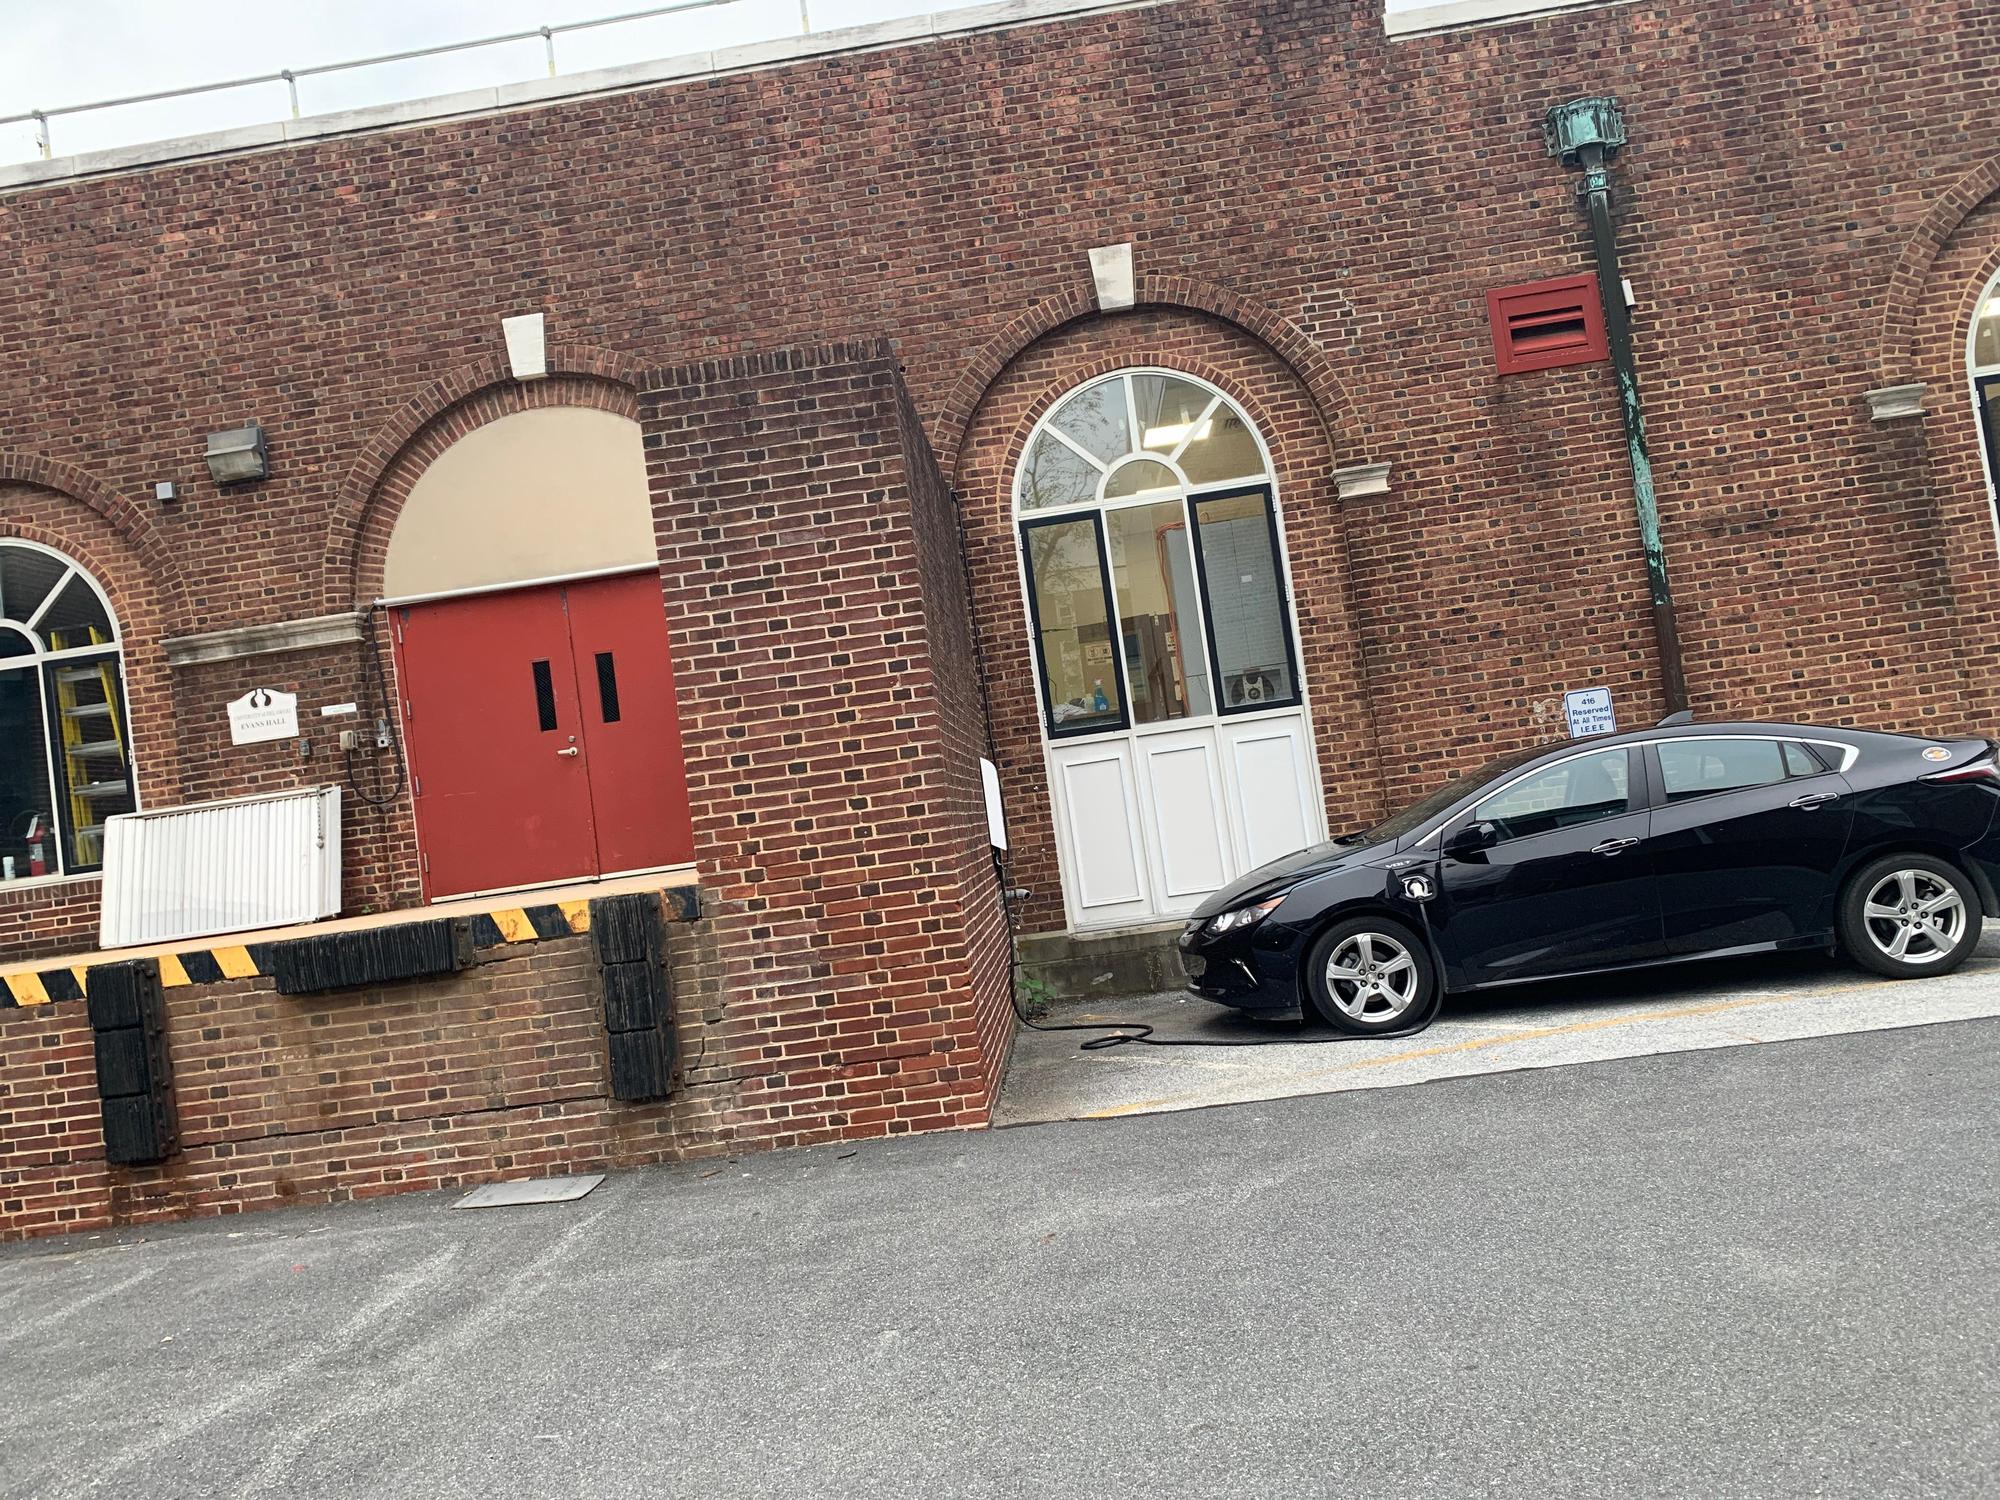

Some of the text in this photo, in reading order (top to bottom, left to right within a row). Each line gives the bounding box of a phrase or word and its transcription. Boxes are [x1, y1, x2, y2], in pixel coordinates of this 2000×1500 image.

[1572, 705, 1609, 716] Reserved
[241, 718, 286, 730] EVANS HALL
